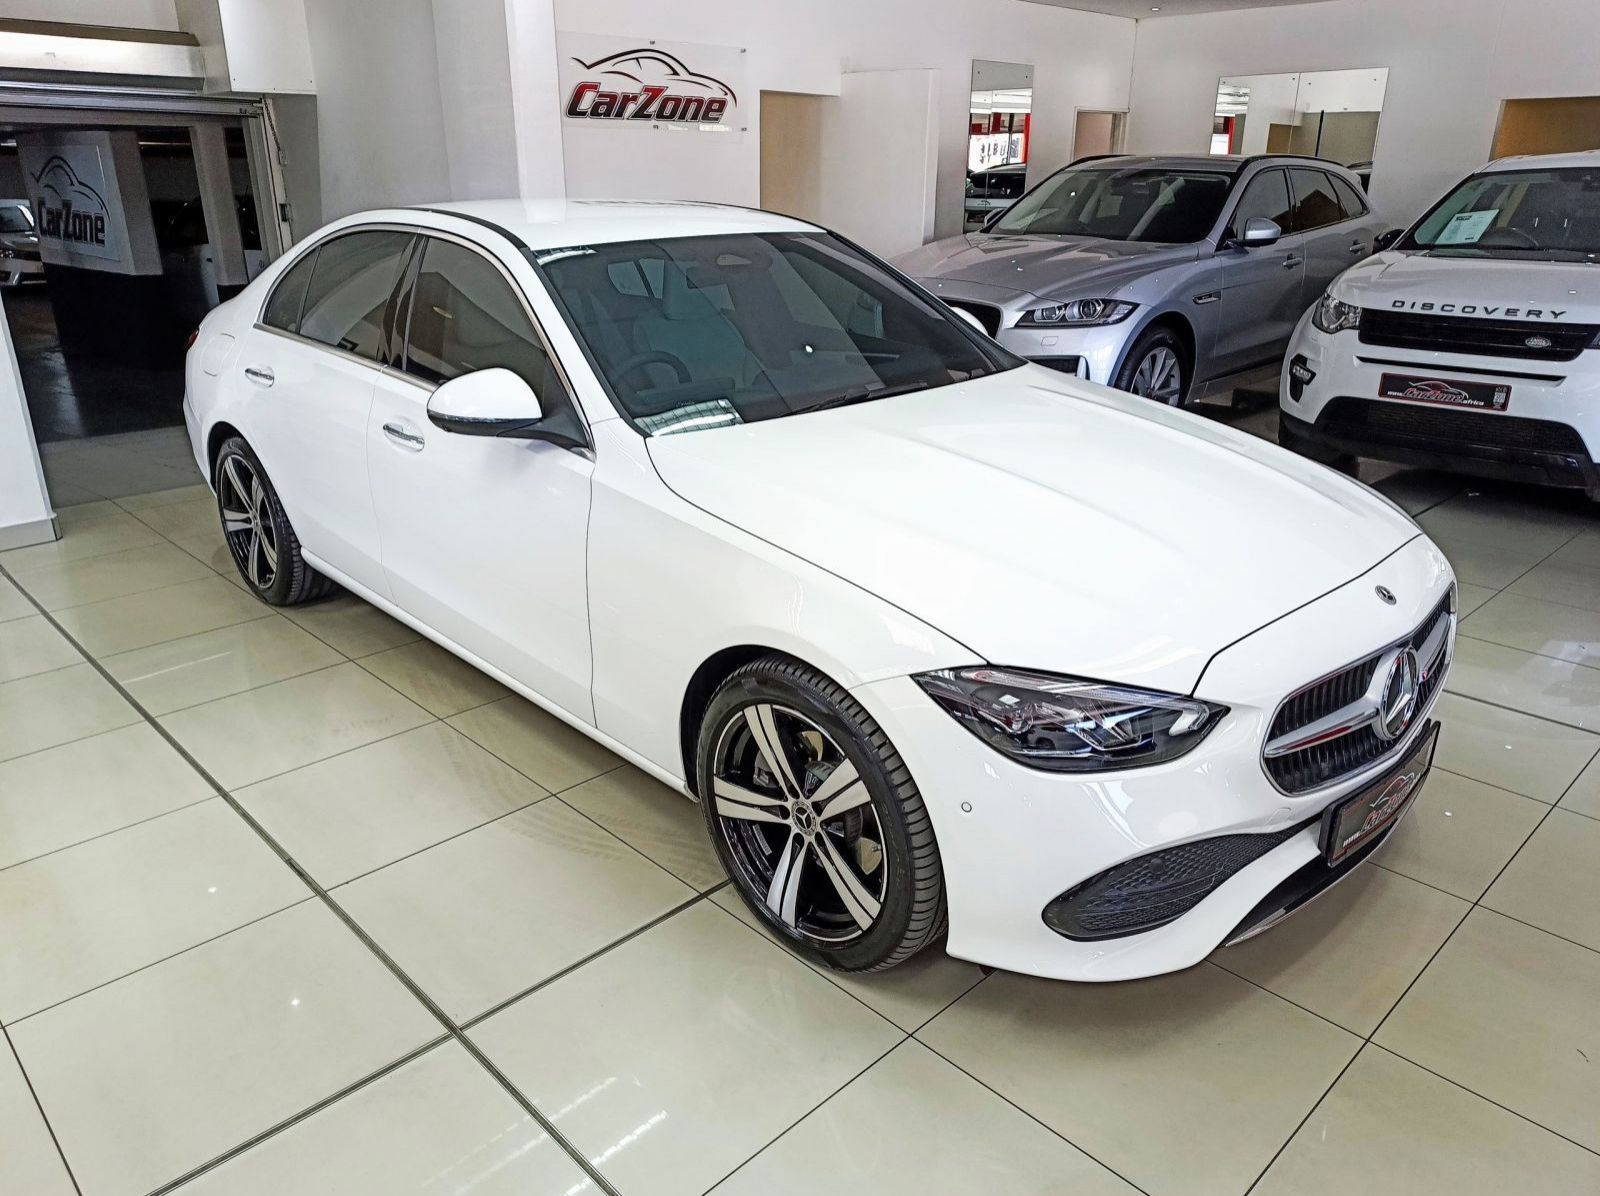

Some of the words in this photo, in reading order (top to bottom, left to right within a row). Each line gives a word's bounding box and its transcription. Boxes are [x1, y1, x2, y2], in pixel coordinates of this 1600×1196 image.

[566, 81, 728, 123] CarZone
[38, 197, 105, 246] CarZone
[1392, 300, 1567, 319] DISCOVERY
